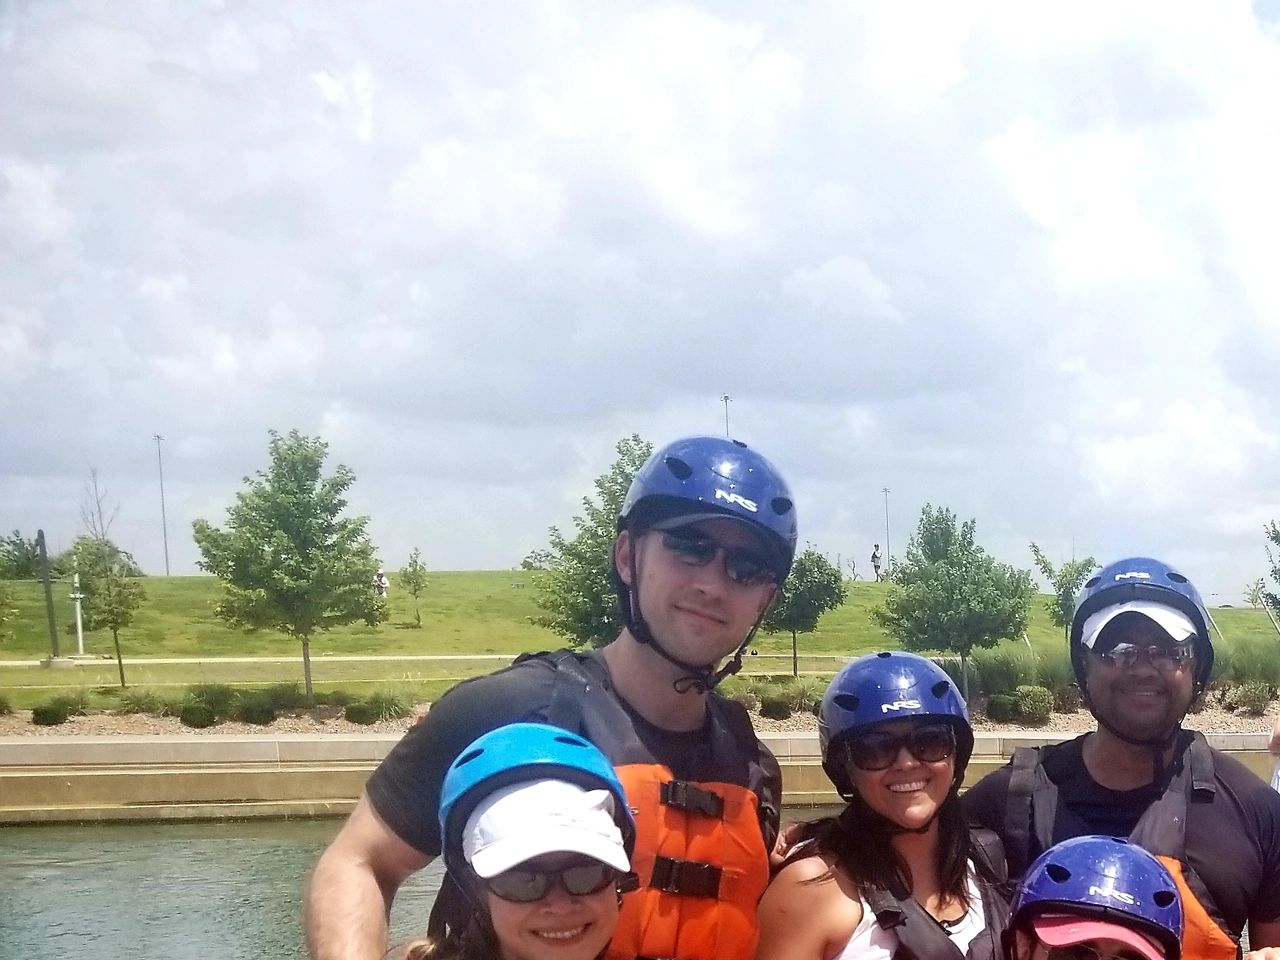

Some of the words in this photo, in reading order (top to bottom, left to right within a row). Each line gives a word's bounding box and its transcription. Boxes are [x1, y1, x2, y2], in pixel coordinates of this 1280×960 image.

[715, 488, 758, 512] NRS
[1115, 572, 1151, 581] NRS
[881, 700, 921, 713] NRS
[1089, 886, 1134, 905] NRS
